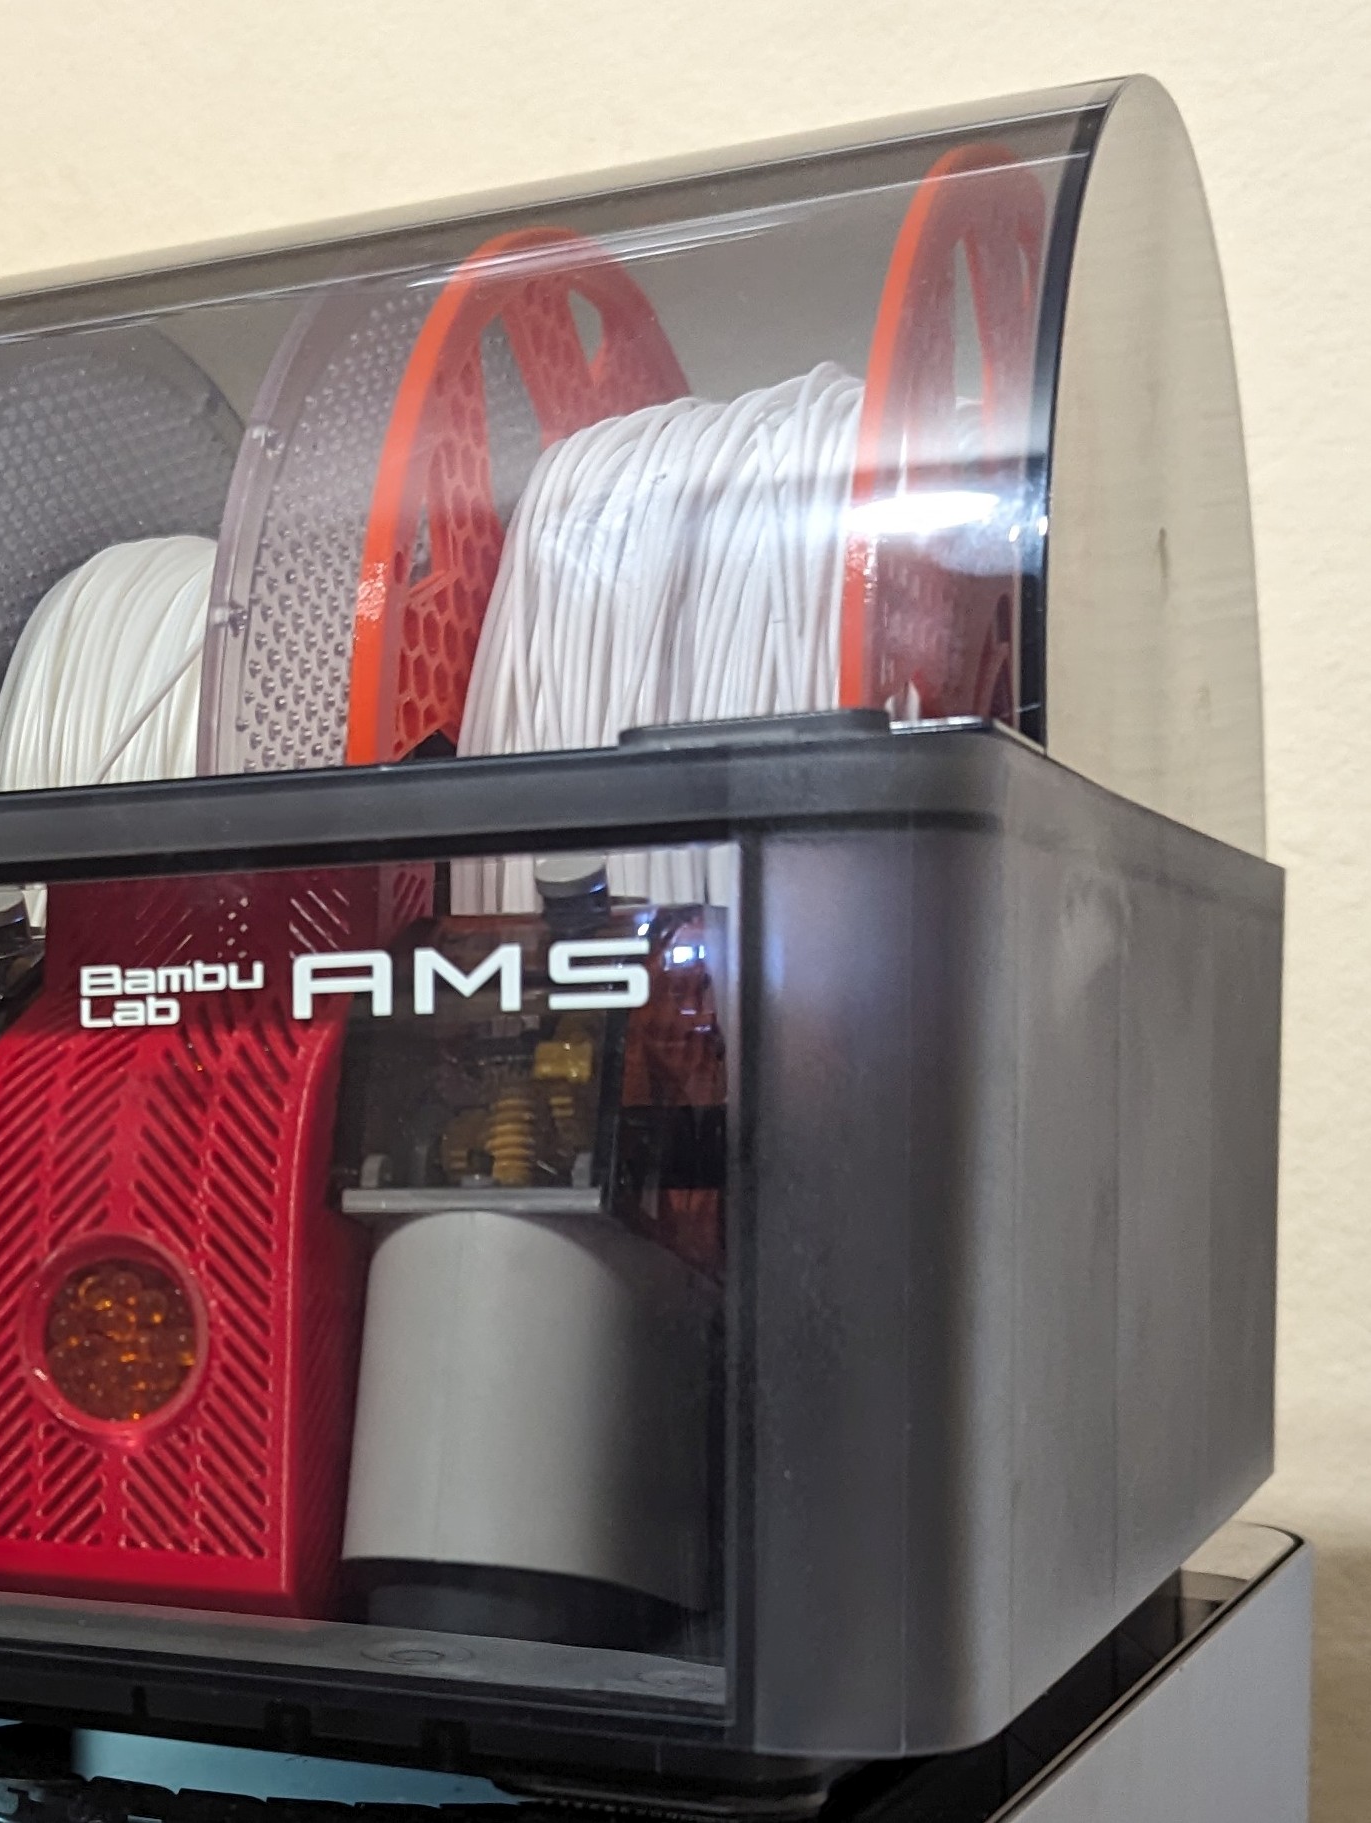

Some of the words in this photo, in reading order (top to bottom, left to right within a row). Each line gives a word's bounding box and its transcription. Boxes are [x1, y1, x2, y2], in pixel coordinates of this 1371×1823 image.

[80, 960, 265, 996] Bambu
[292, 938, 650, 1020] AMS
[80, 995, 180, 1028] Lab
